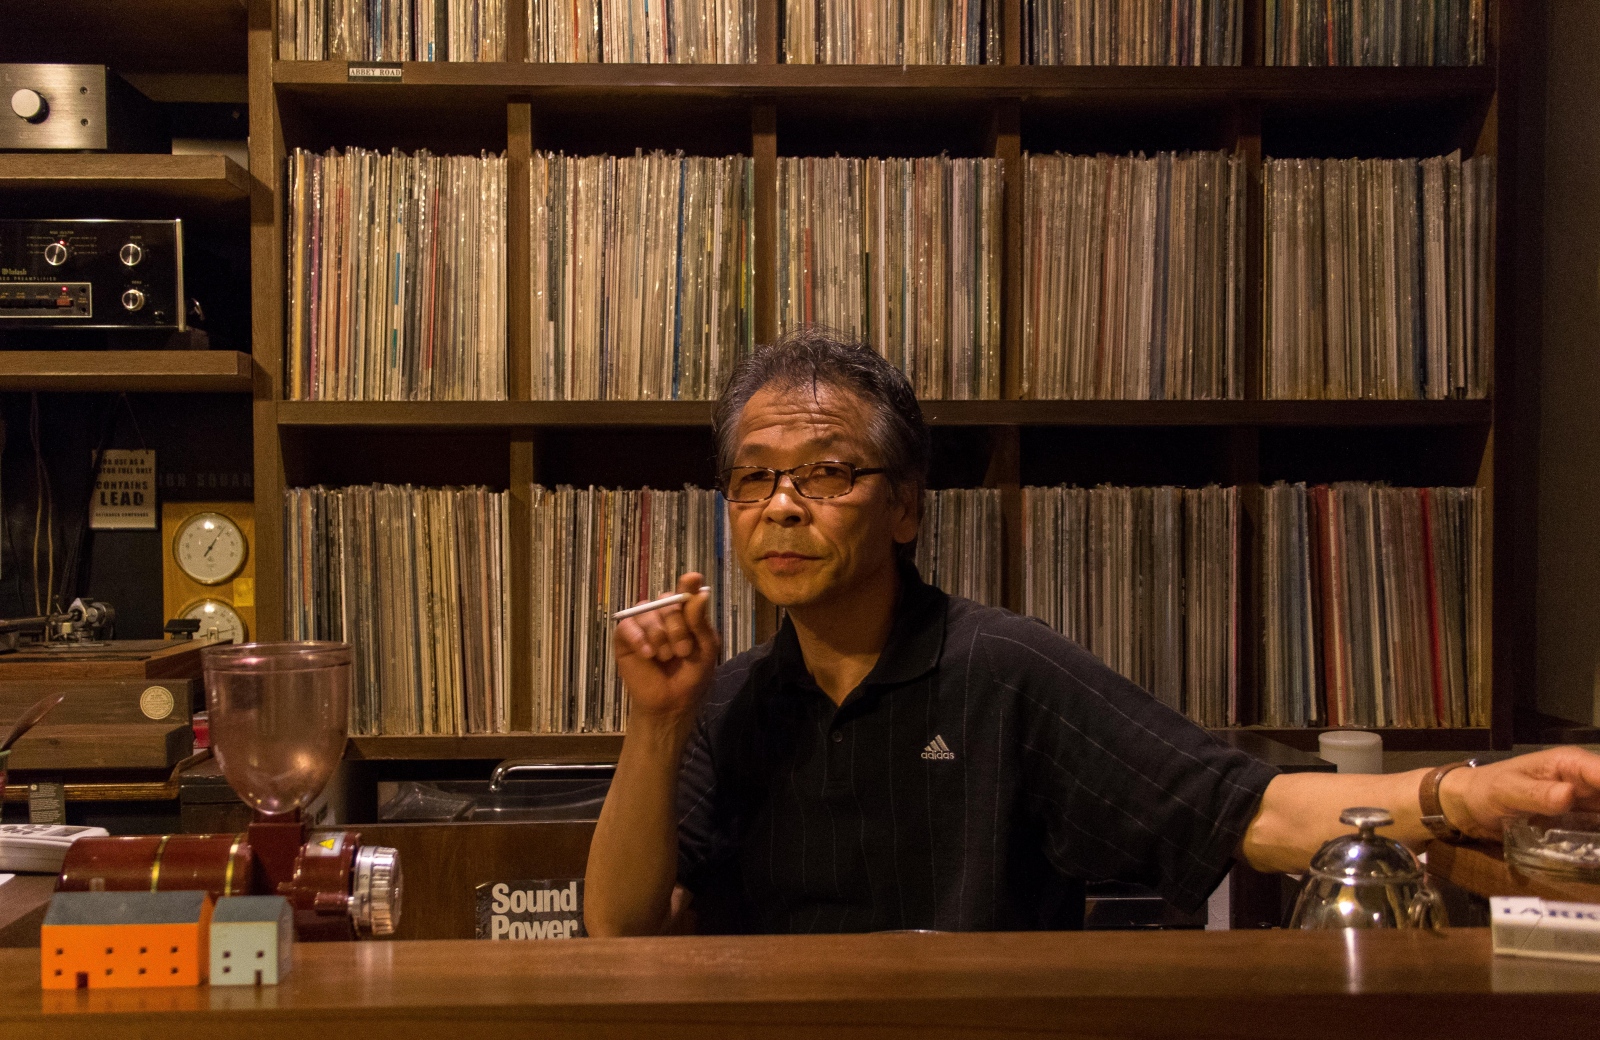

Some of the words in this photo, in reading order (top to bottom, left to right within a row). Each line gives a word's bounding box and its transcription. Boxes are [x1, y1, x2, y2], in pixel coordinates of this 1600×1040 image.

[351, 68, 375, 76] ABBEY
[95, 481, 148, 490] CONTAINS
[100, 491, 144, 506] LEAD
[920, 749, 955, 760] adidas
[491, 881, 577, 914] Sound
[491, 914, 579, 940] Power
